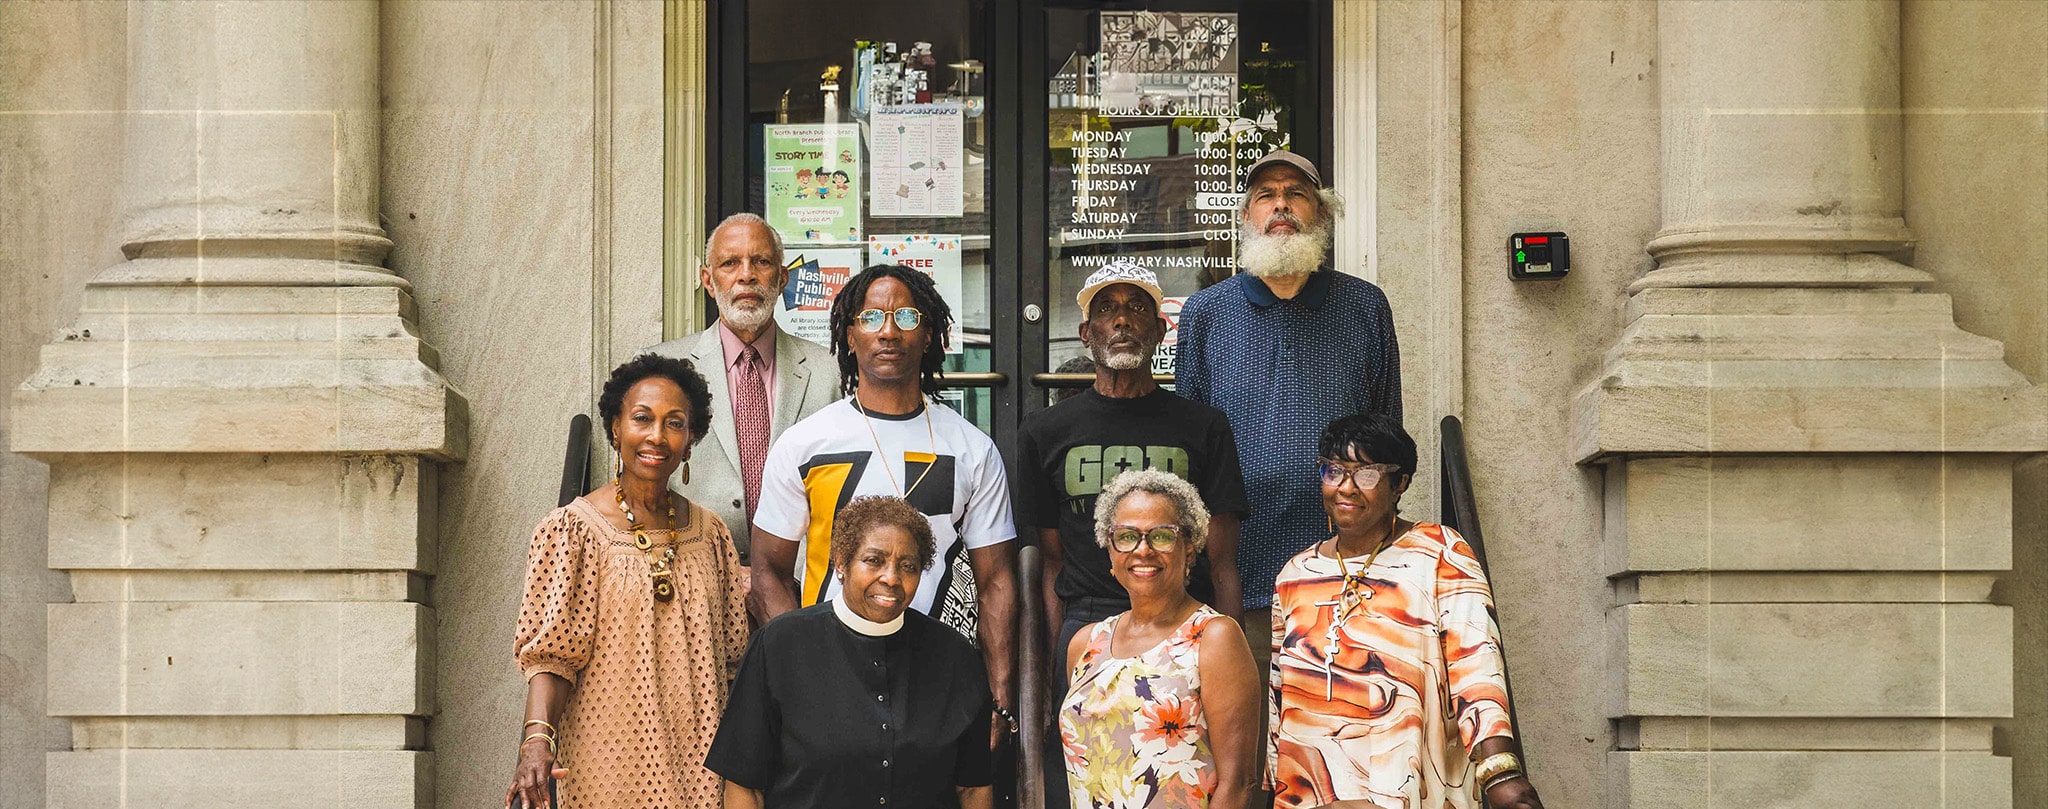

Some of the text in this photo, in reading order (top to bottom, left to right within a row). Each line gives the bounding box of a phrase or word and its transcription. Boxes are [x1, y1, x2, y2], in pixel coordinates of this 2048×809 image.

[1099, 105, 1240, 116] HOURS OF OPERATION
[1071, 131, 1132, 142] MONDAY
[775, 151, 806, 160] STORY
[1071, 147, 1127, 158] TUESDAY
[1236, 148, 1263, 159] 6:00
[1071, 164, 1151, 175] WEDNESDAY
[1071, 180, 1137, 191] THURSDAY
[1071, 196, 1117, 207] FRIDAY
[1071, 213, 1138, 224] SATURDAY
[1071, 229, 1240, 241] SUNDAY CLOS
[897, 259, 933, 268] FREE
[798, 268, 850, 285] Nashville
[796, 280, 833, 297] Public
[794, 293, 834, 309] Library
[1065, 445, 1189, 496] GOD
